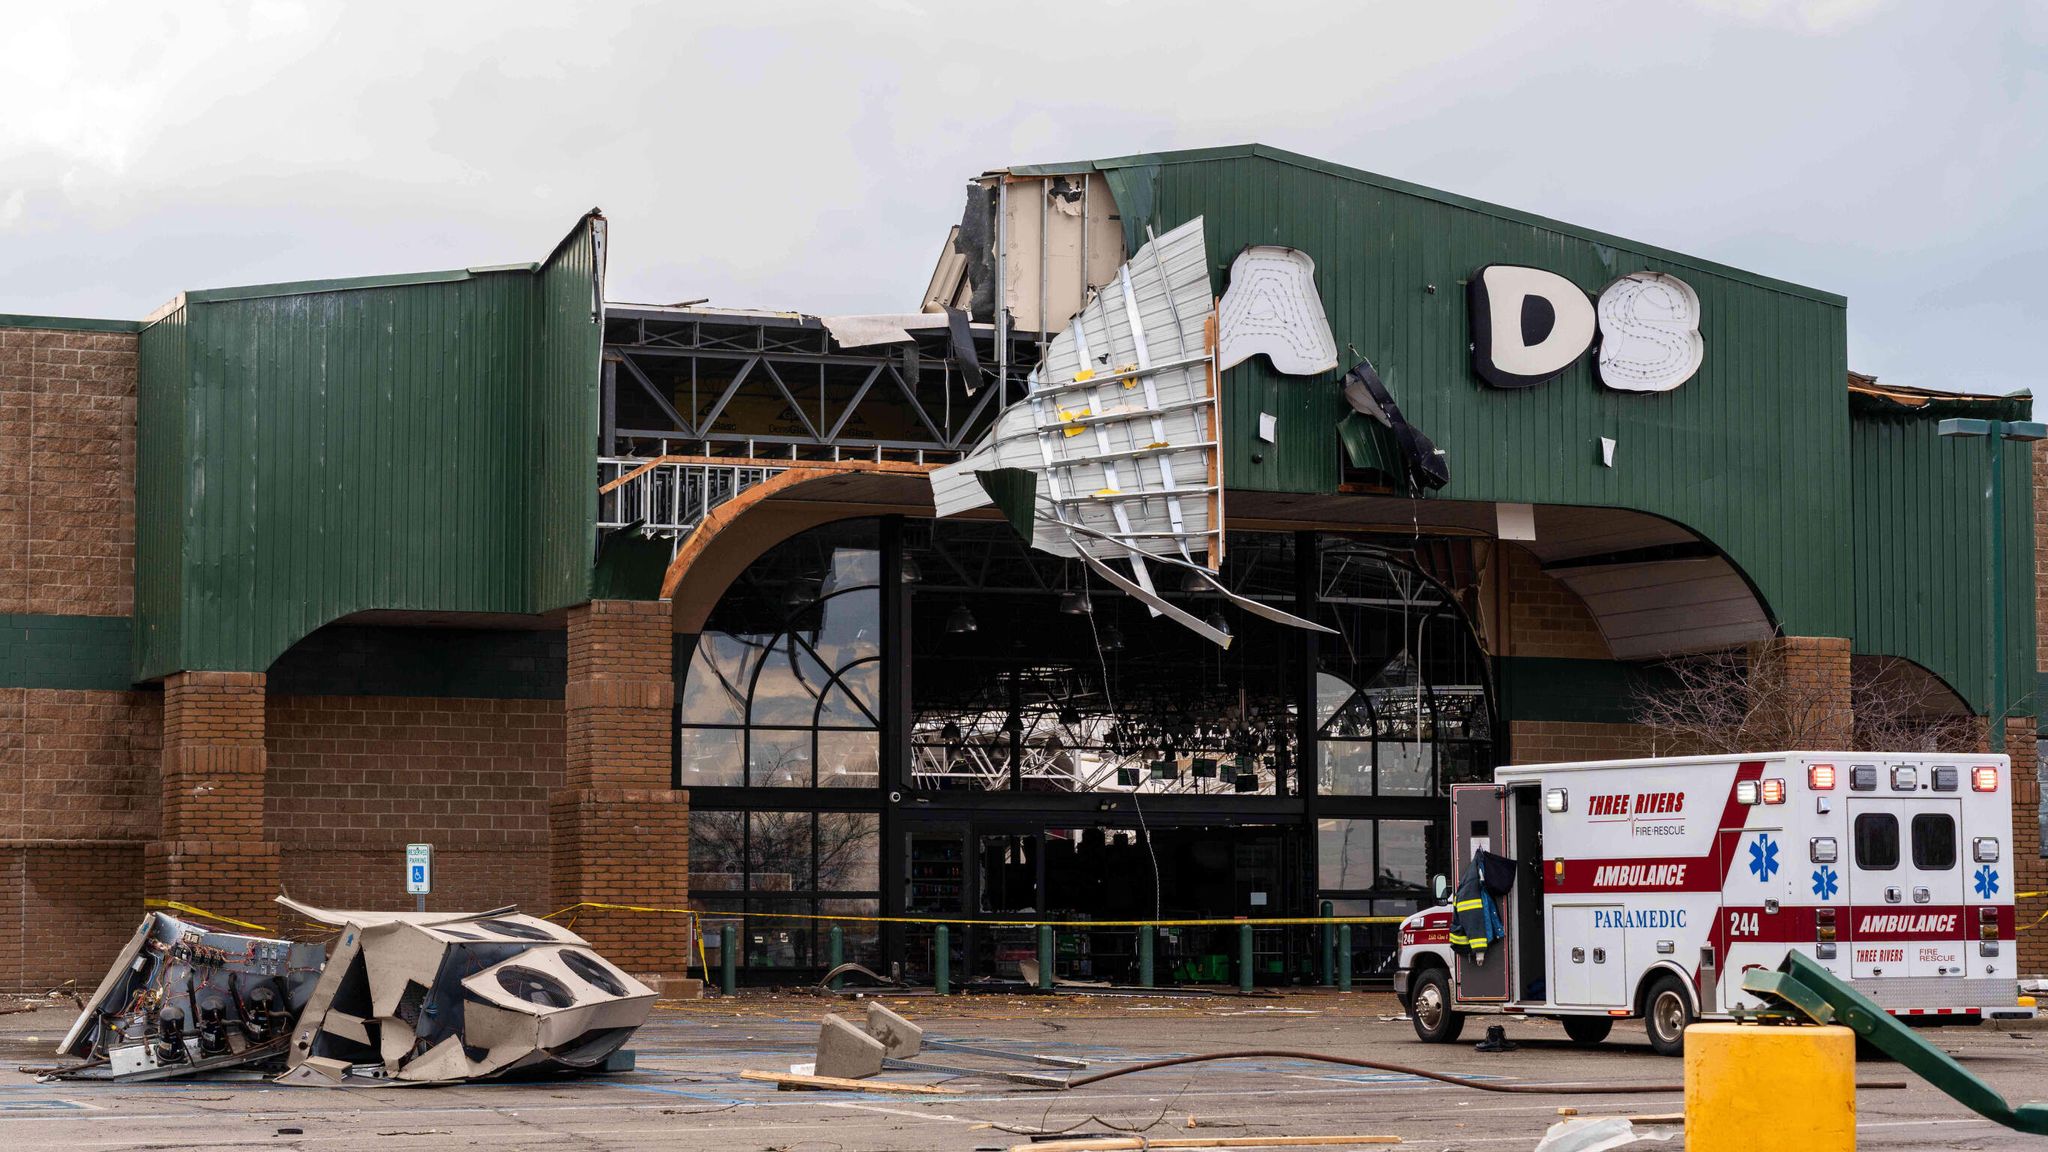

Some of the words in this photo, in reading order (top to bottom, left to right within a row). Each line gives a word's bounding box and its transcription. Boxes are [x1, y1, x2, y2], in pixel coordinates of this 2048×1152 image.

[1588, 794, 1630, 816] THREE
[1634, 791, 1685, 814] RIVERS
[1593, 865, 1687, 887] AMBULANCE
[1594, 909, 1687, 929] PARAMEDIC
[1730, 911, 1760, 937] 244
[1858, 914, 1958, 933] AMBULANCE
[1403, 933, 1415, 945] 244
[1856, 949, 1877, 963] THREE
[1879, 948, 1904, 962] RIVERS
